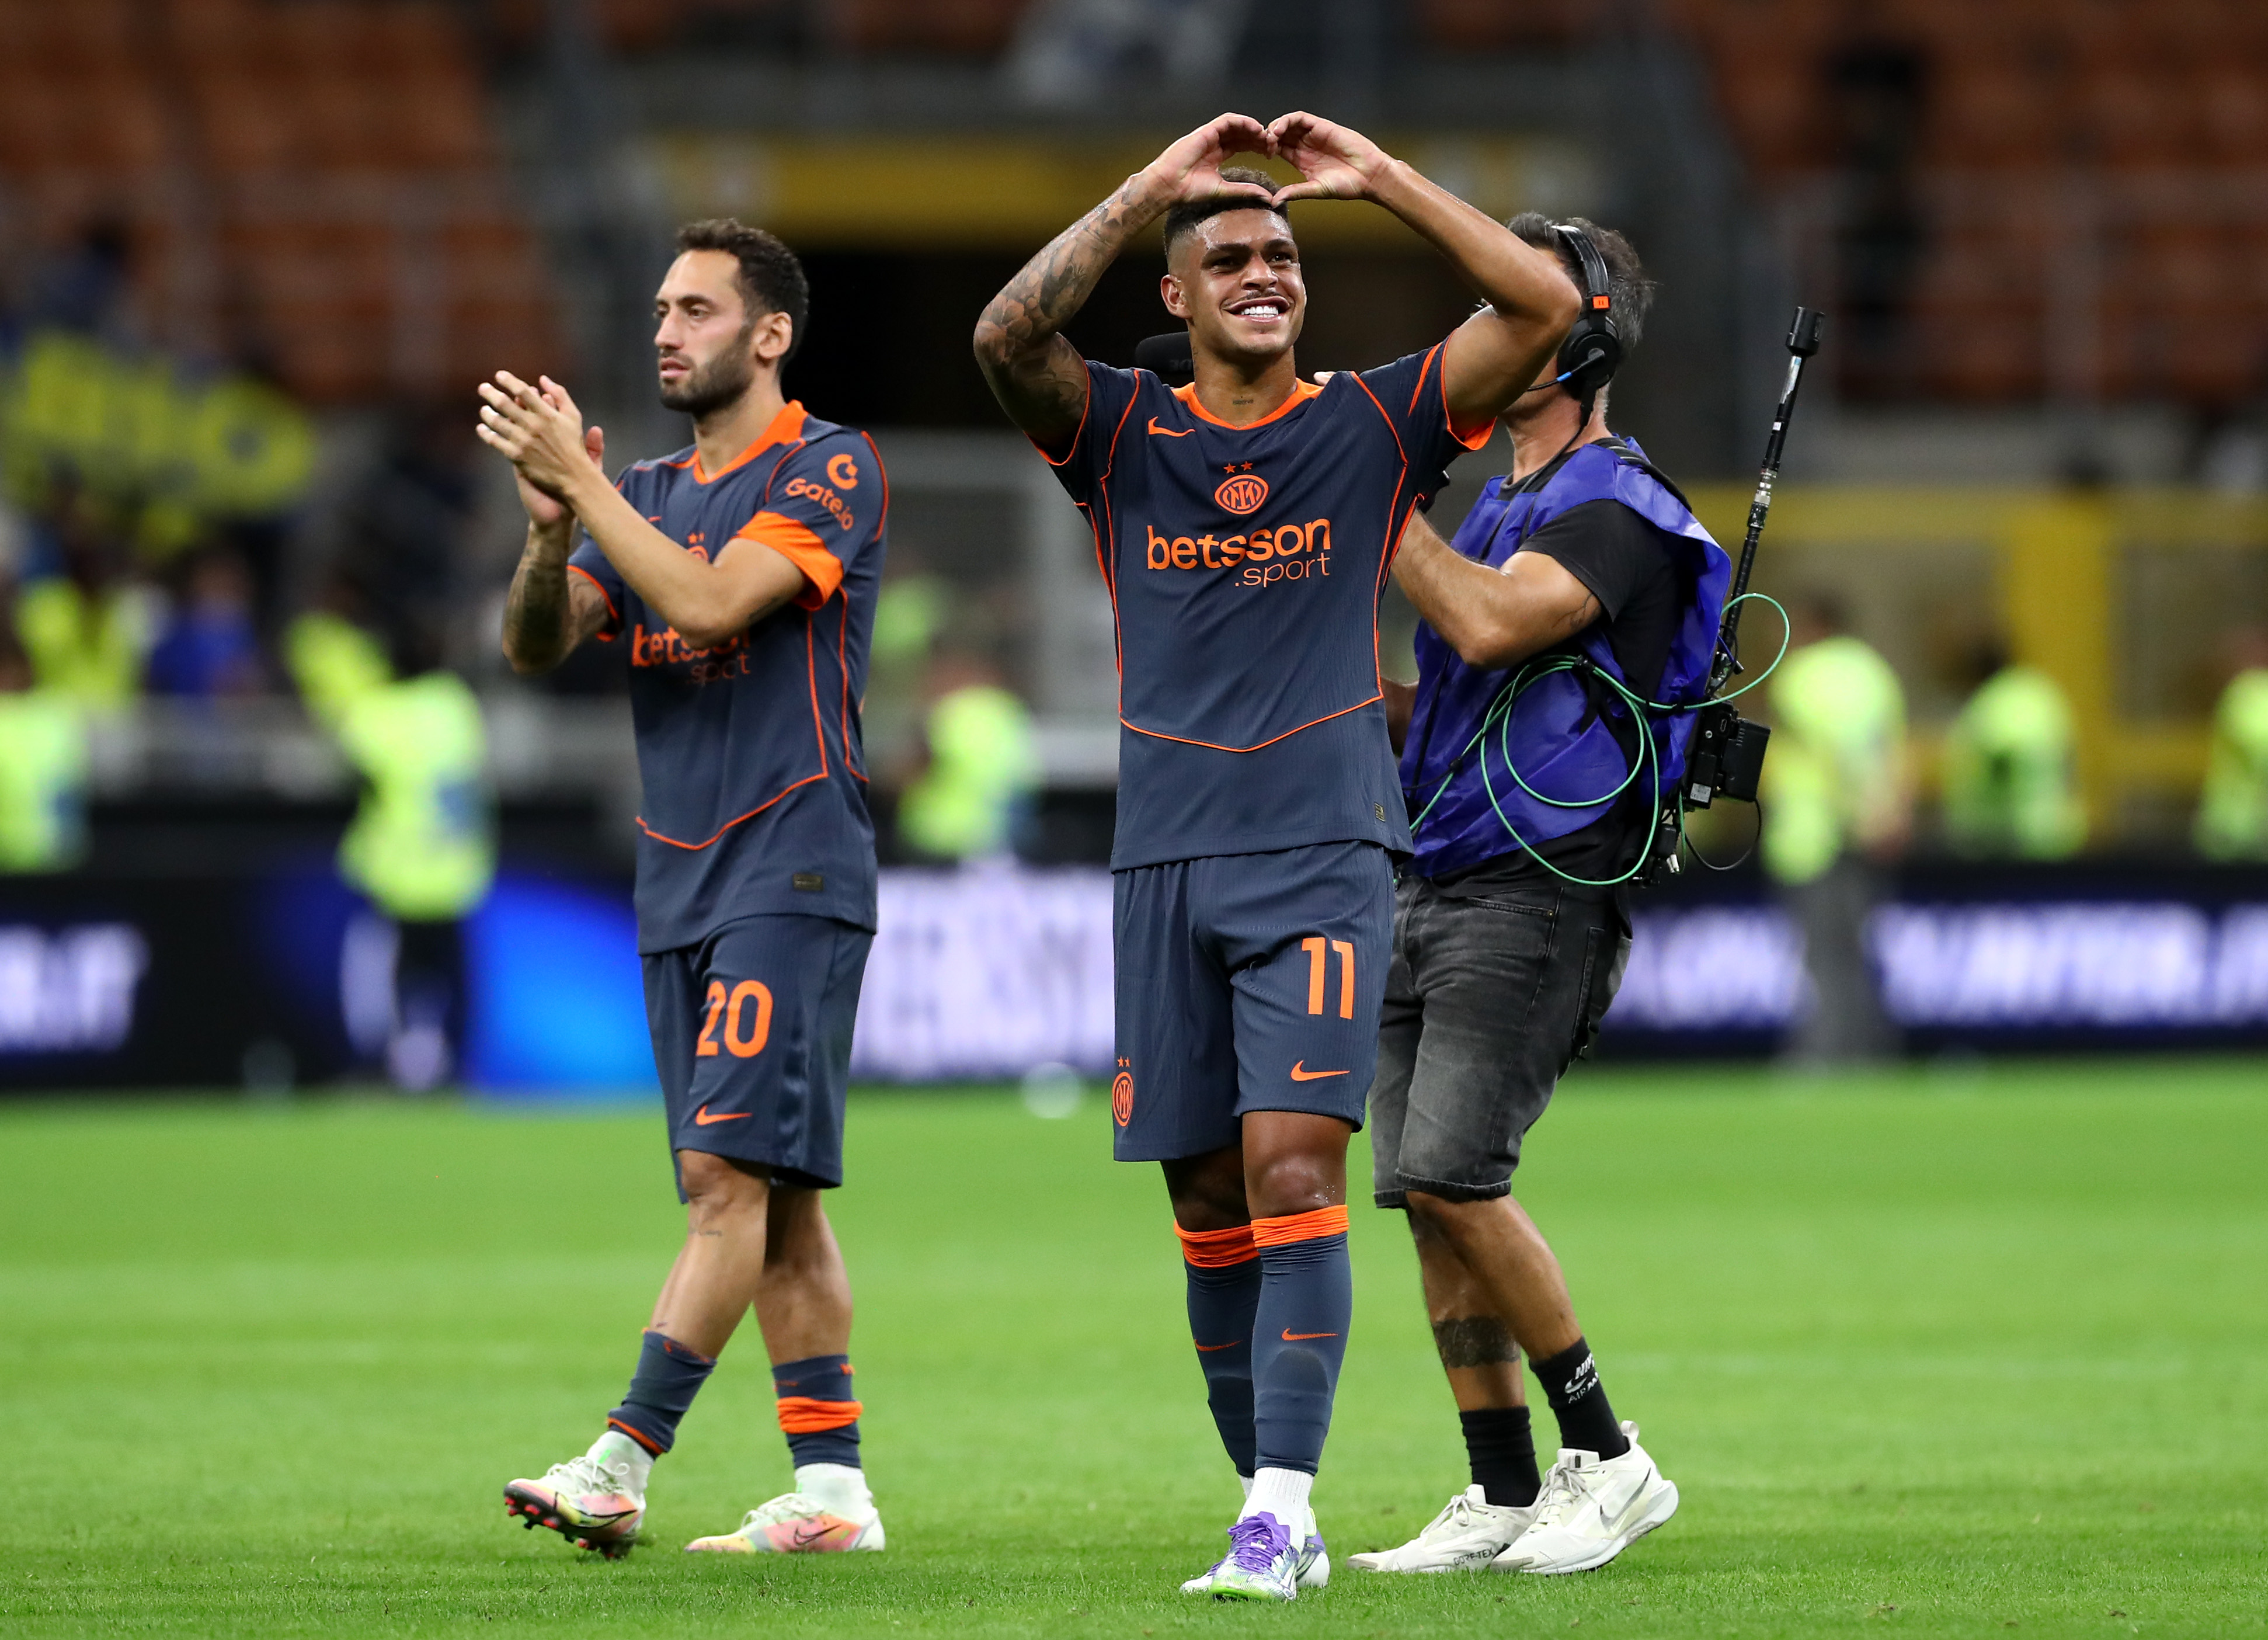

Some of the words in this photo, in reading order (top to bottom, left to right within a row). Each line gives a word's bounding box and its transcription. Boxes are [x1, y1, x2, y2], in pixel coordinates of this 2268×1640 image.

[1147, 518, 1331, 570] betsson
[1234, 552, 1330, 588] .sport
[1302, 937, 1355, 1020] 11
[696, 979, 774, 1058] 20
[1453, 1547, 1495, 1566] GORE-TEX
